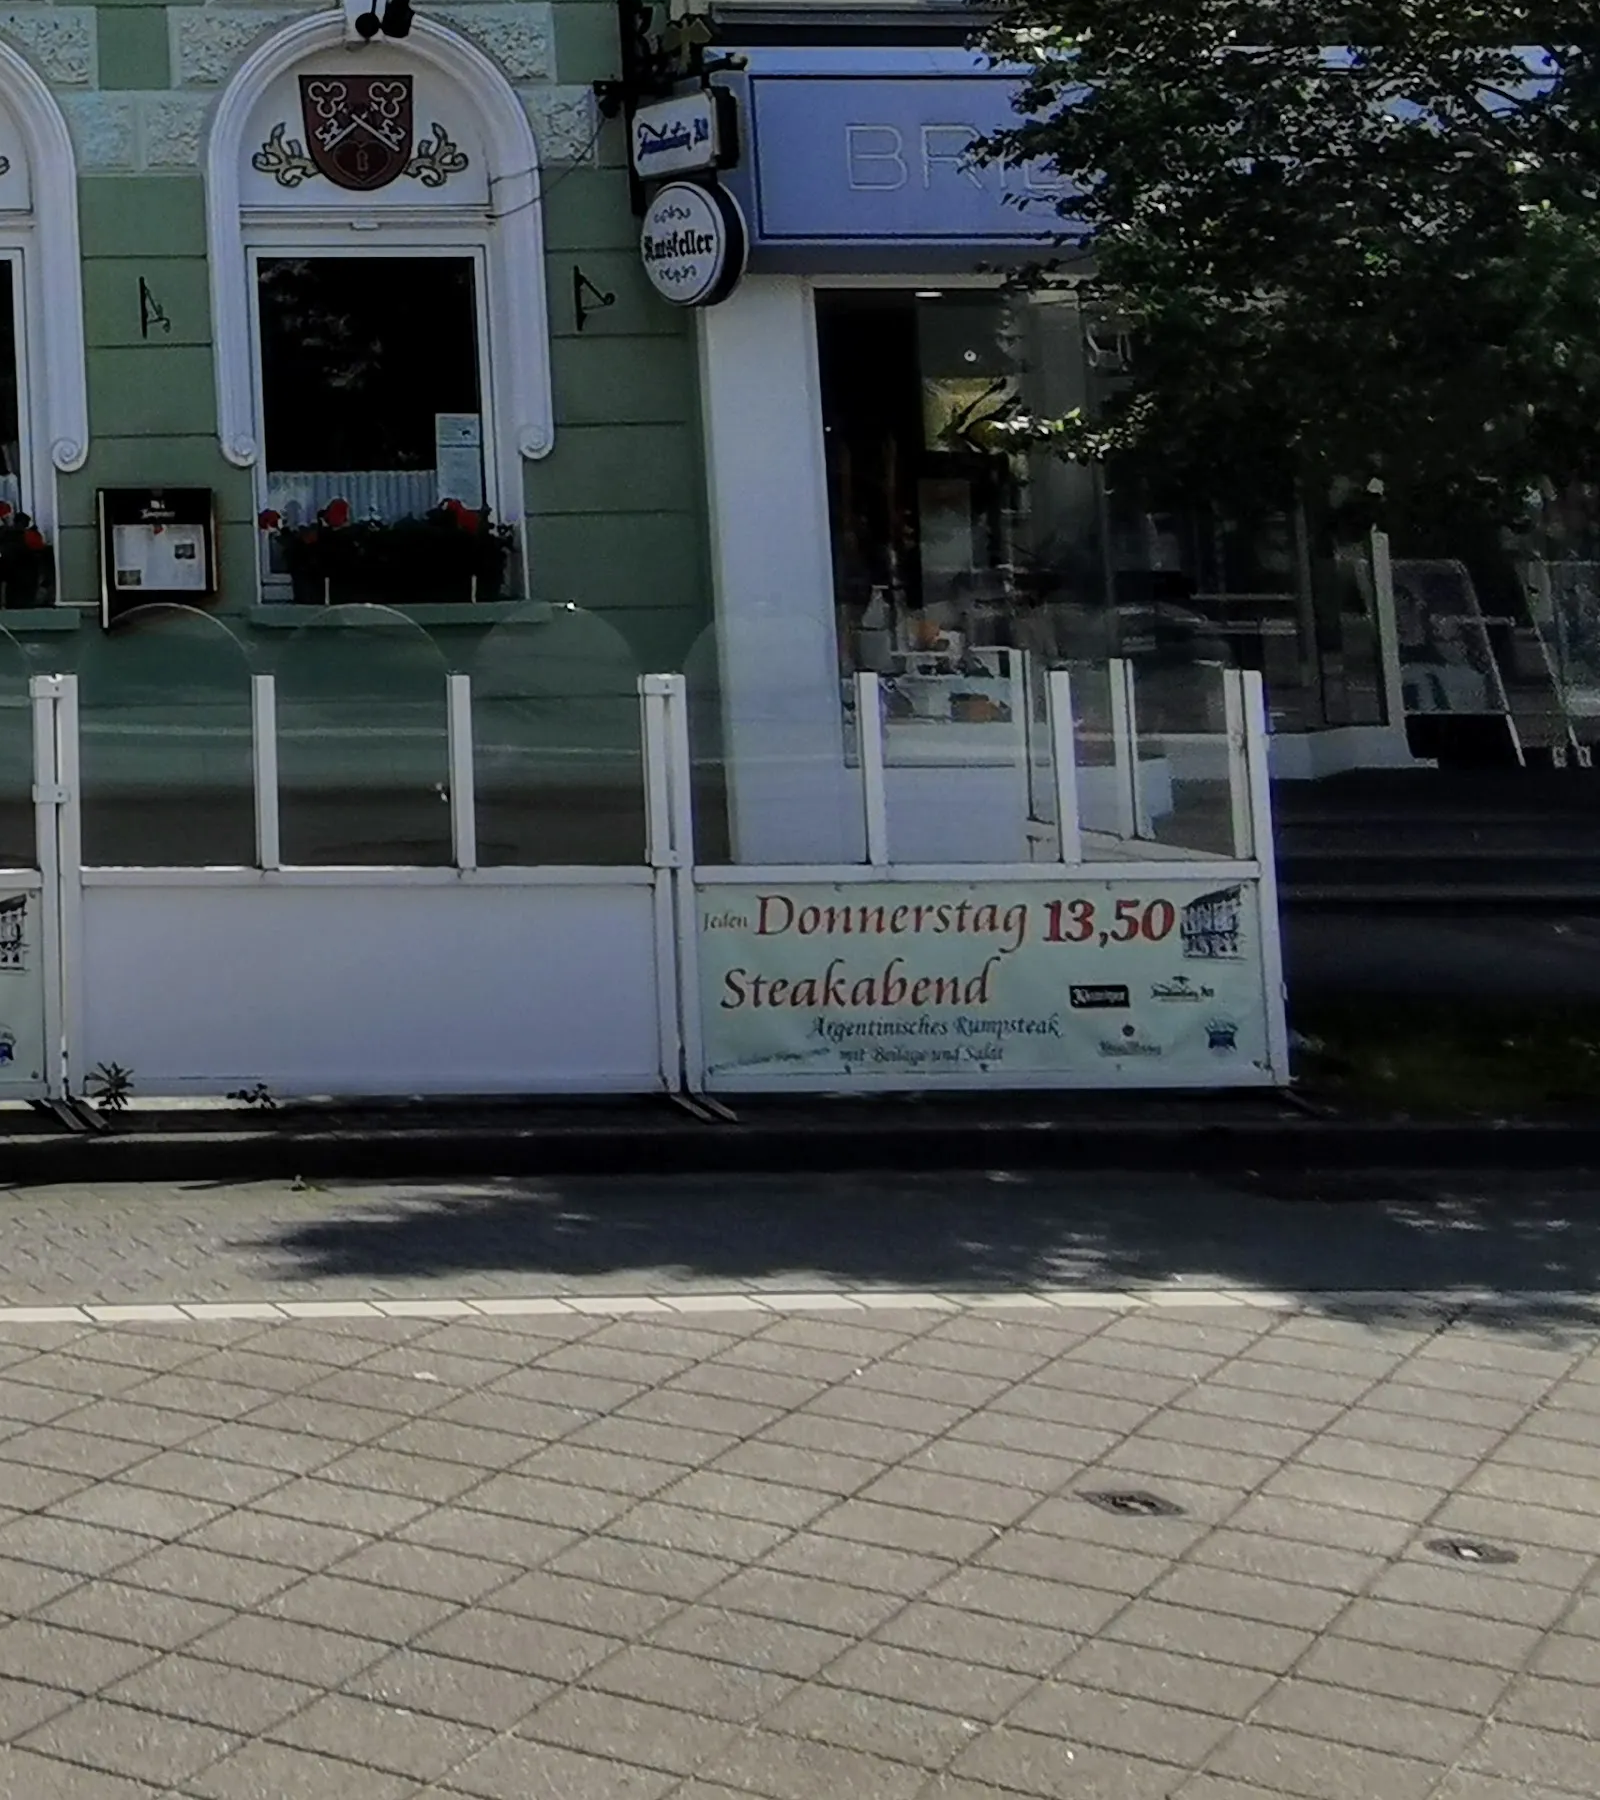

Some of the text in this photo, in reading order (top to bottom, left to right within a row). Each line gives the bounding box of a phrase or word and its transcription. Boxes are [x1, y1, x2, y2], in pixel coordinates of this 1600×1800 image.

[703, 895, 1176, 954] Jeden Donnerstag 13,50
[720, 957, 1002, 1008] Steakabend
[806, 1013, 1064, 1043] Argentinisches Rumpsteak
